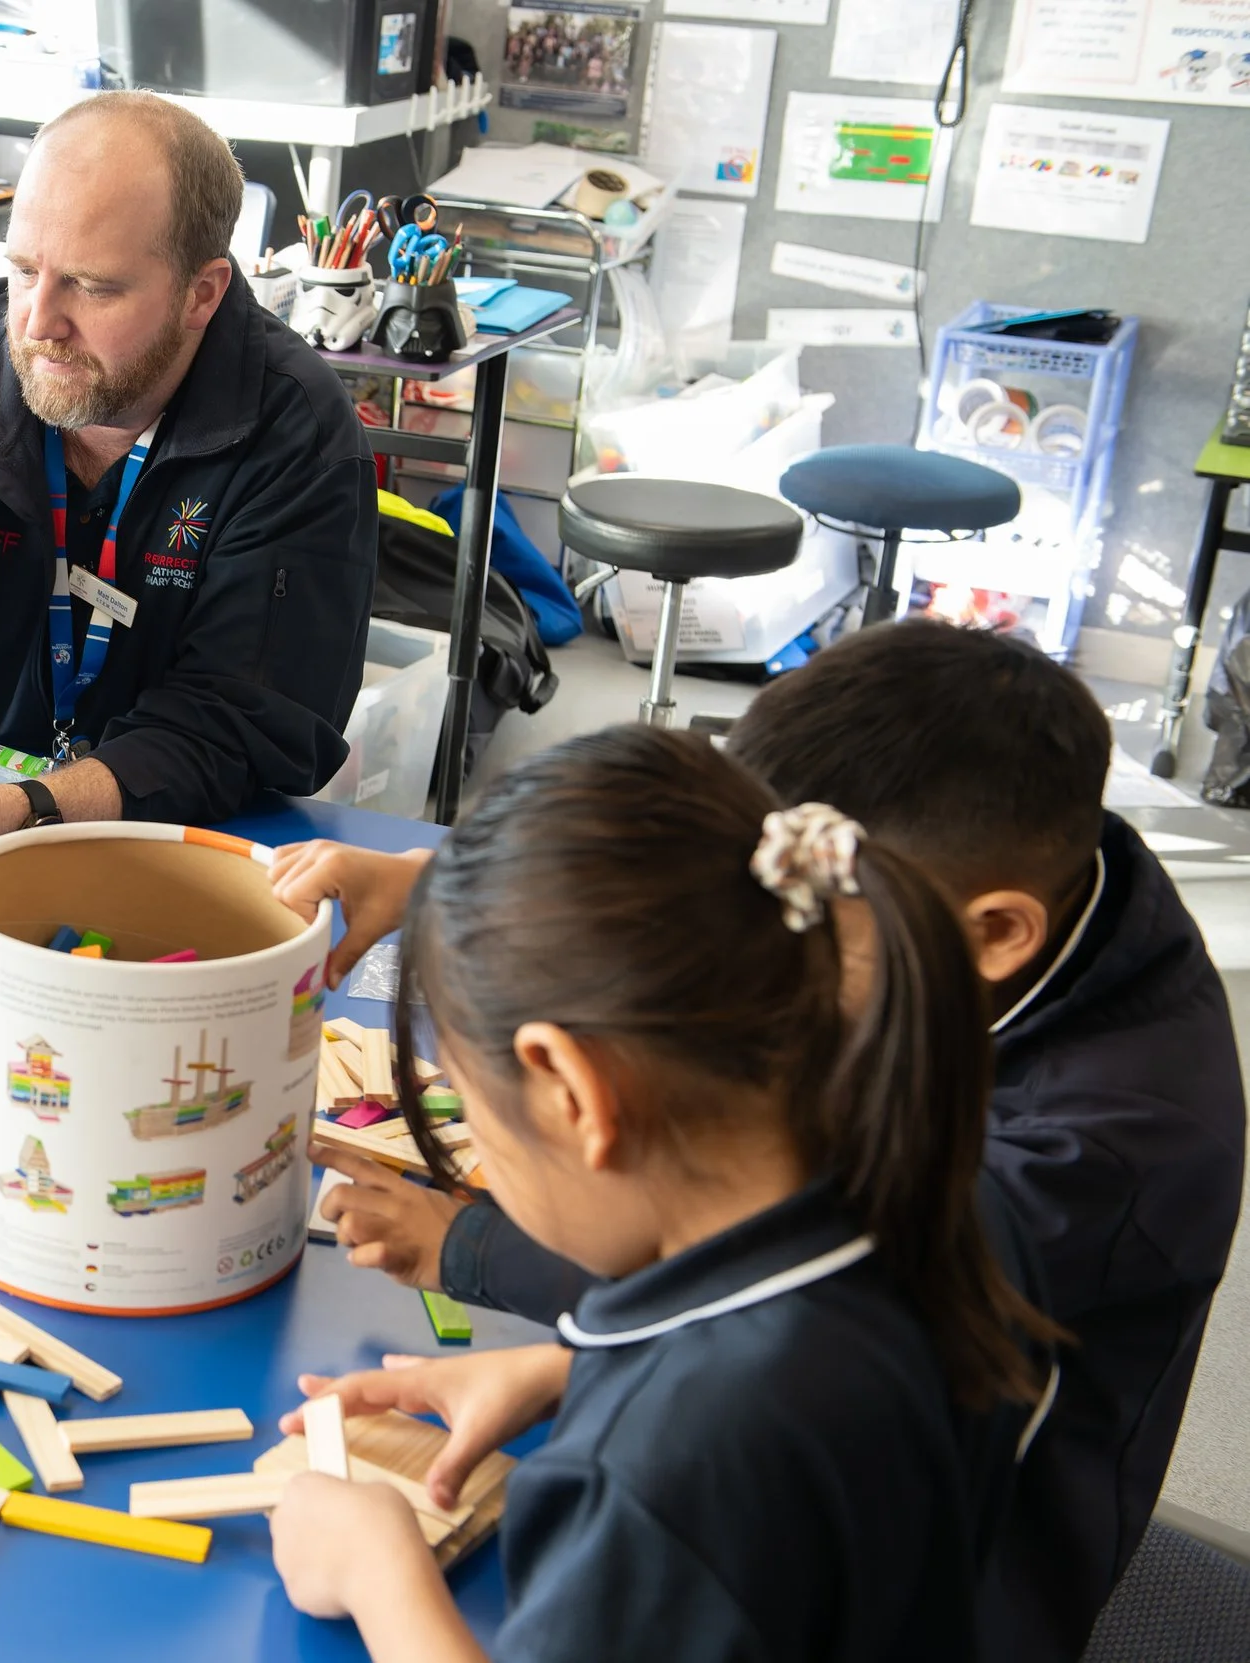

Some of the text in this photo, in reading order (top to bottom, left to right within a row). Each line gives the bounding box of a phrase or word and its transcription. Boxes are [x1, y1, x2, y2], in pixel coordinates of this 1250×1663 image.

[152, 566, 196, 580] CATHOLIC
[97, 589, 110, 601] Matt
[110, 597, 128, 612] Dalton
